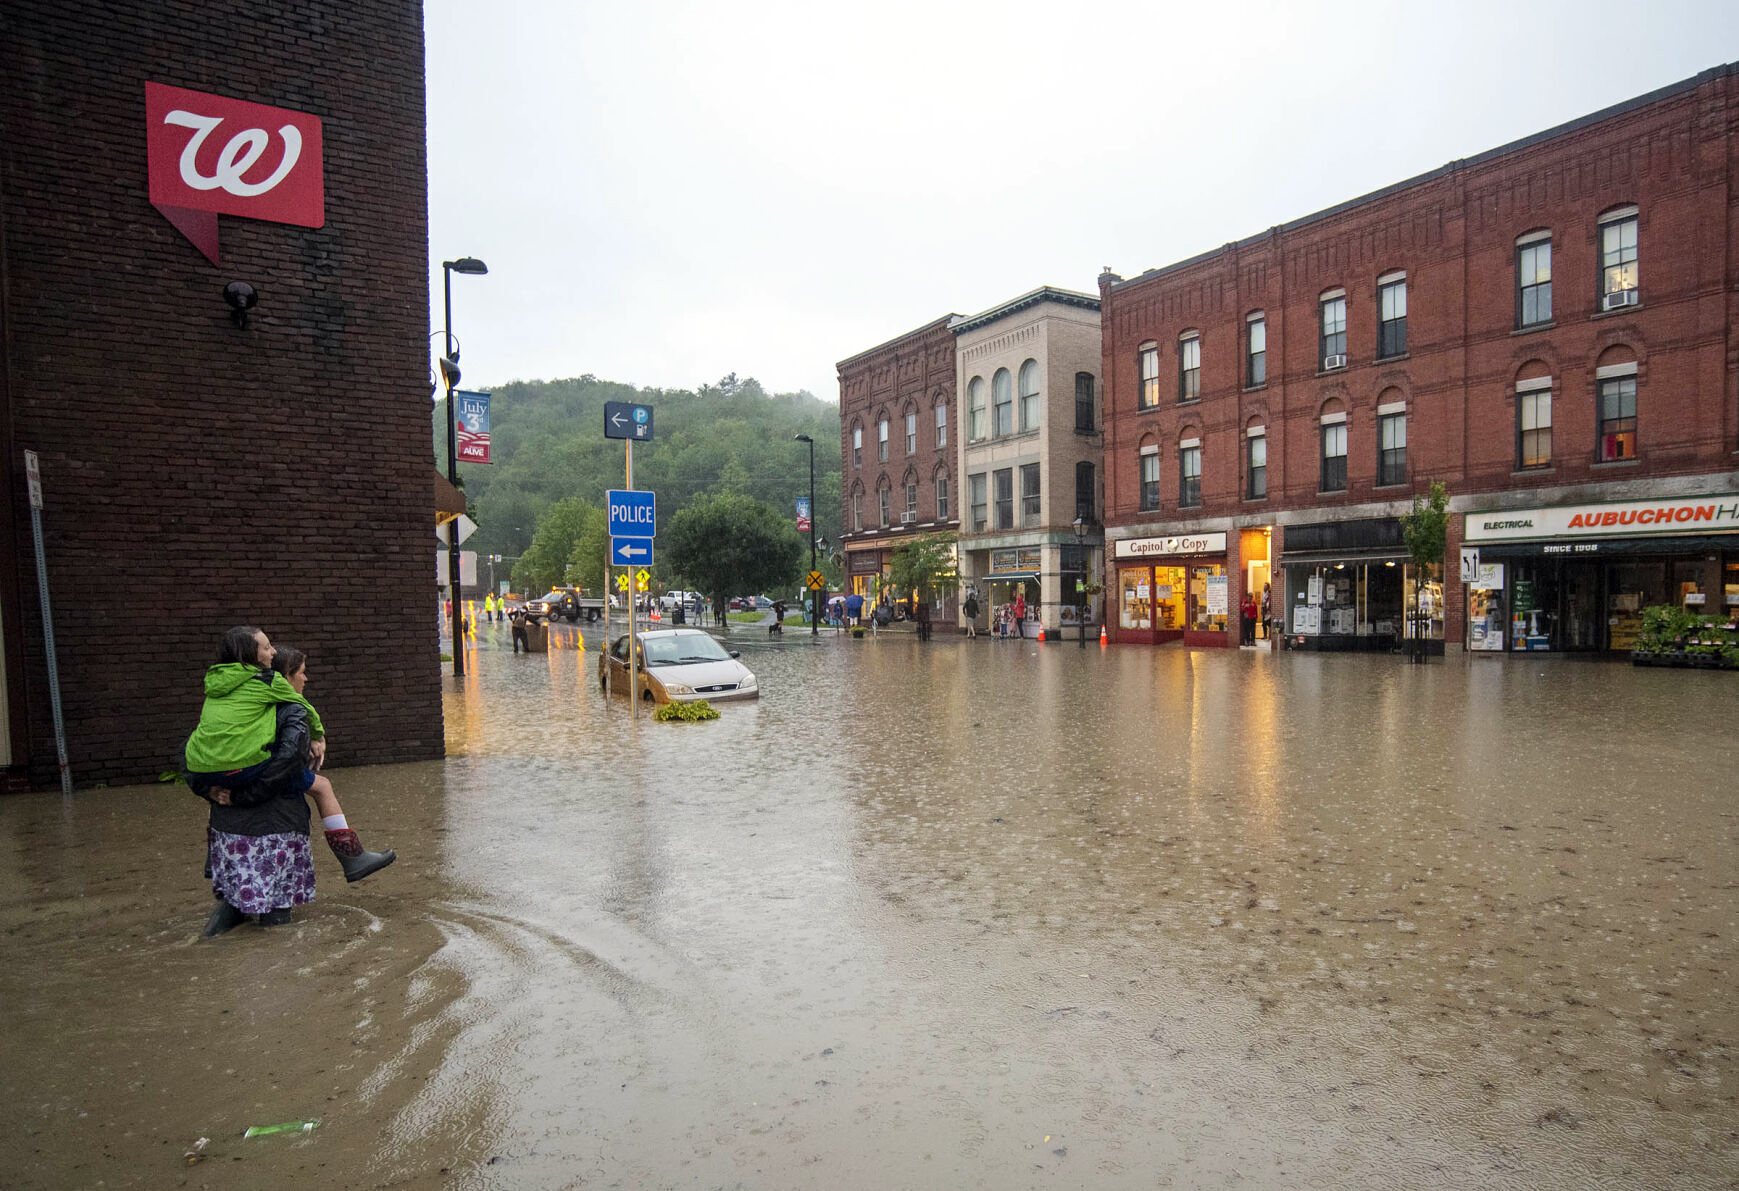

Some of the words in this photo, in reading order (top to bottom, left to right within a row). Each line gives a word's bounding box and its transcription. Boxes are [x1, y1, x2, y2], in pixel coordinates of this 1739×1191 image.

[461, 400, 487, 417] July
[636, 409, 646, 423] P
[611, 504, 653, 523] POLICE
[1567, 505, 1716, 528] AUBUCHON
[1483, 519, 1534, 530] ELECTRICAL
[1130, 541, 1163, 555] Capitol
[1182, 538, 1208, 552] Copy
[1543, 545, 1572, 553] SINCE
